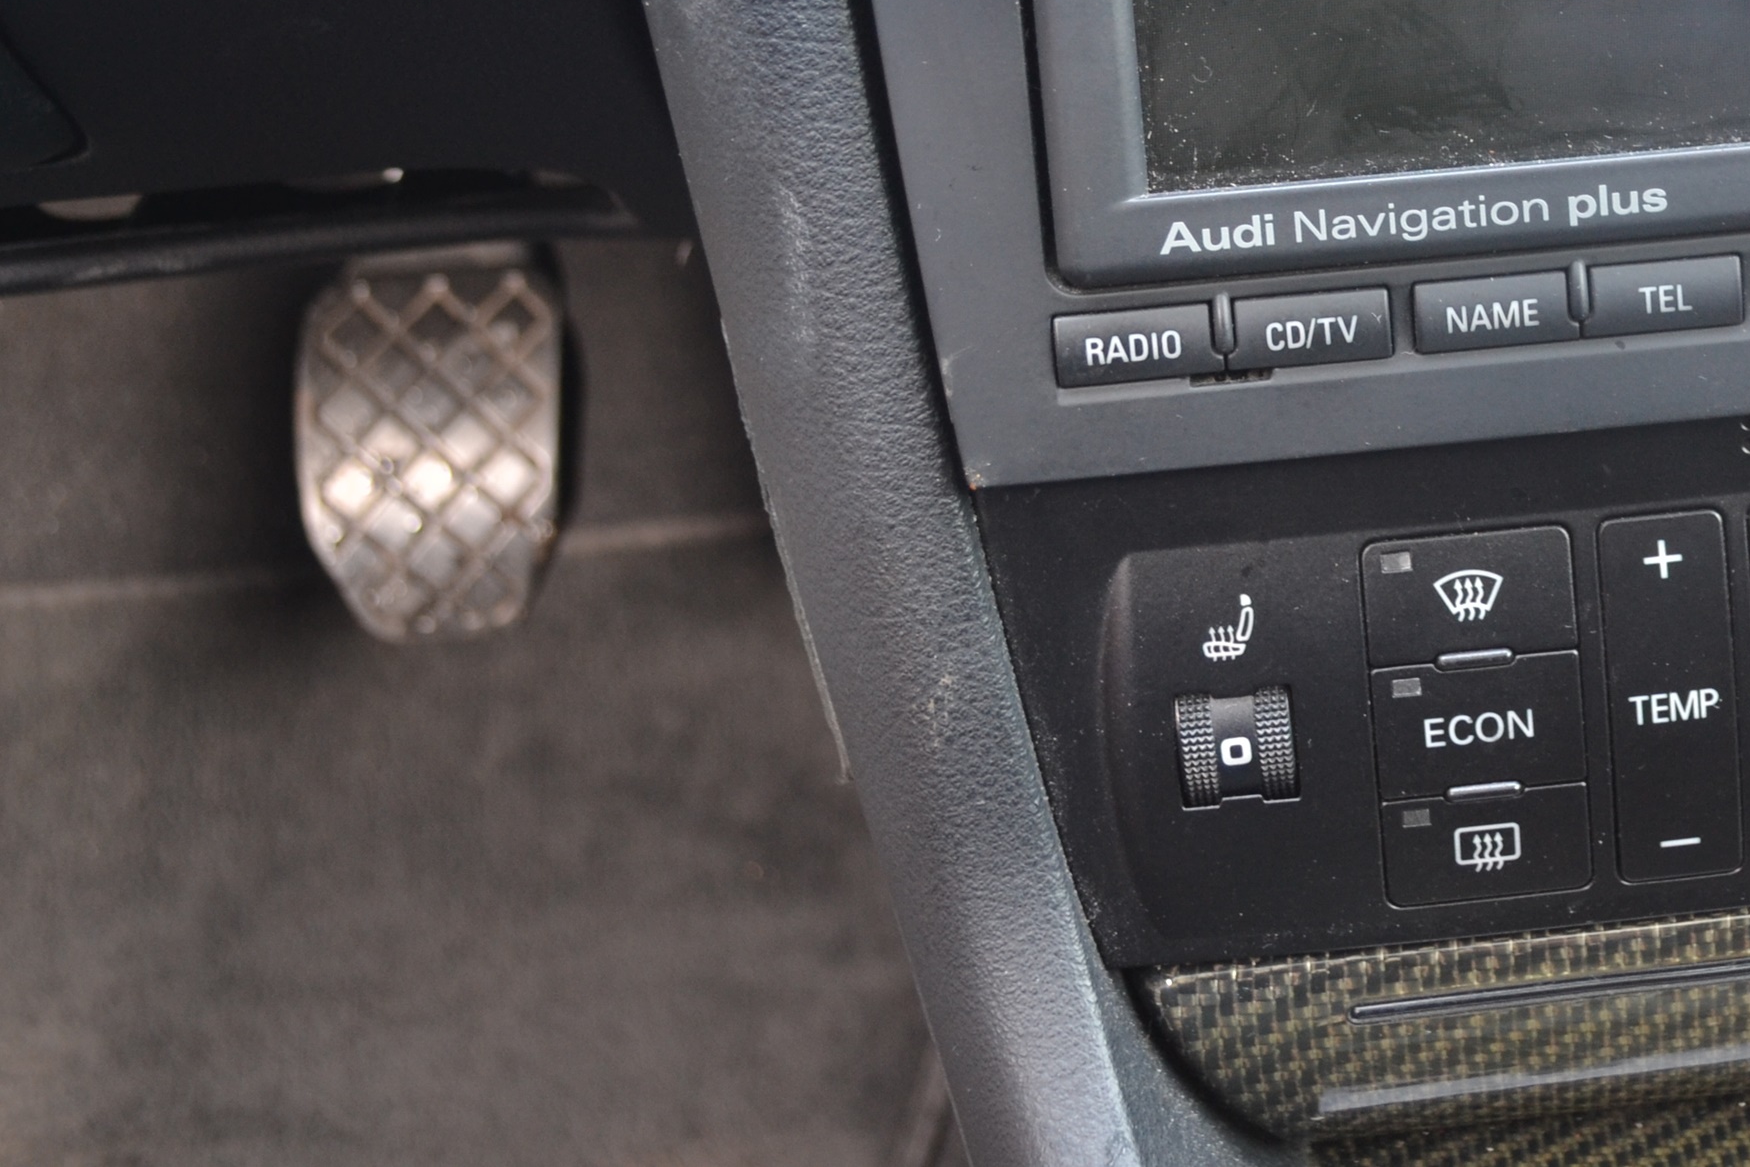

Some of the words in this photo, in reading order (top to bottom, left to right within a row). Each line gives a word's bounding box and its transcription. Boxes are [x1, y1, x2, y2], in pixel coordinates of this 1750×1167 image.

[1159, 213, 1276, 256] Audi
[1293, 193, 1550, 243] Navigation
[1567, 183, 1669, 227] plus
[1445, 298, 1540, 334] NAME
[1637, 283, 1693, 315] TEL
[1084, 329, 1183, 366] RADIO
[1265, 314, 1359, 352] CD/TV
[1628, 687, 1720, 726] TEMP
[1423, 708, 1535, 749] ECON
